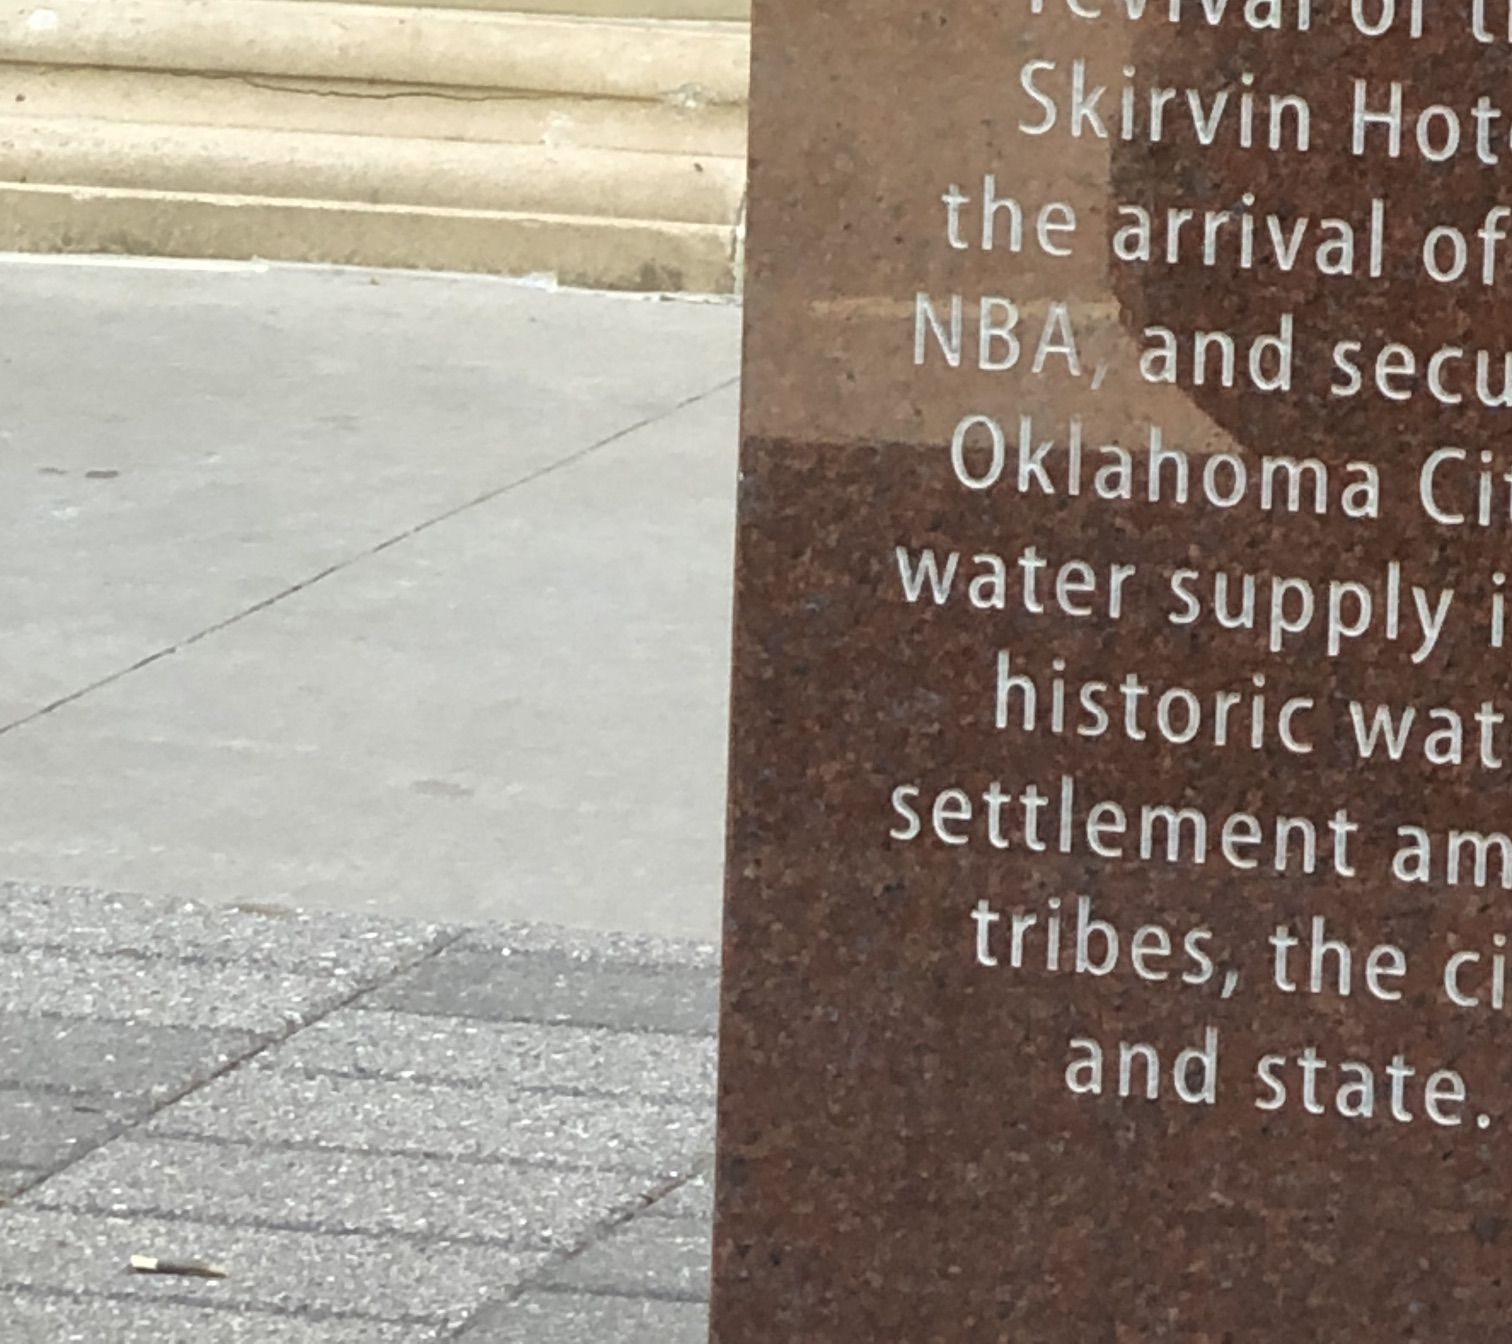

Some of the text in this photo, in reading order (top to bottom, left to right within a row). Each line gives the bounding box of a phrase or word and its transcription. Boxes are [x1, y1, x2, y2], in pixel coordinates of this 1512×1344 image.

[1018, 58, 1310, 152] Skirvin
[941, 173, 1078, 258] the
[1112, 193, 1384, 278] arrival
[1422, 207, 1511, 285] of
[912, 291, 1106, 390] NBA,
[1138, 314, 1293, 392] and
[950, 413, 1379, 518] Oklahoma
[895, 547, 1135, 619] water
[1169, 562, 1453, 664] supply
[995, 651, 1313, 754] historic
[890, 776, 1358, 878] settlement
[970, 897, 1238, 998] tribes,
[1269, 916, 1407, 1001] the
[1065, 1027, 1491, 1129] and state.
